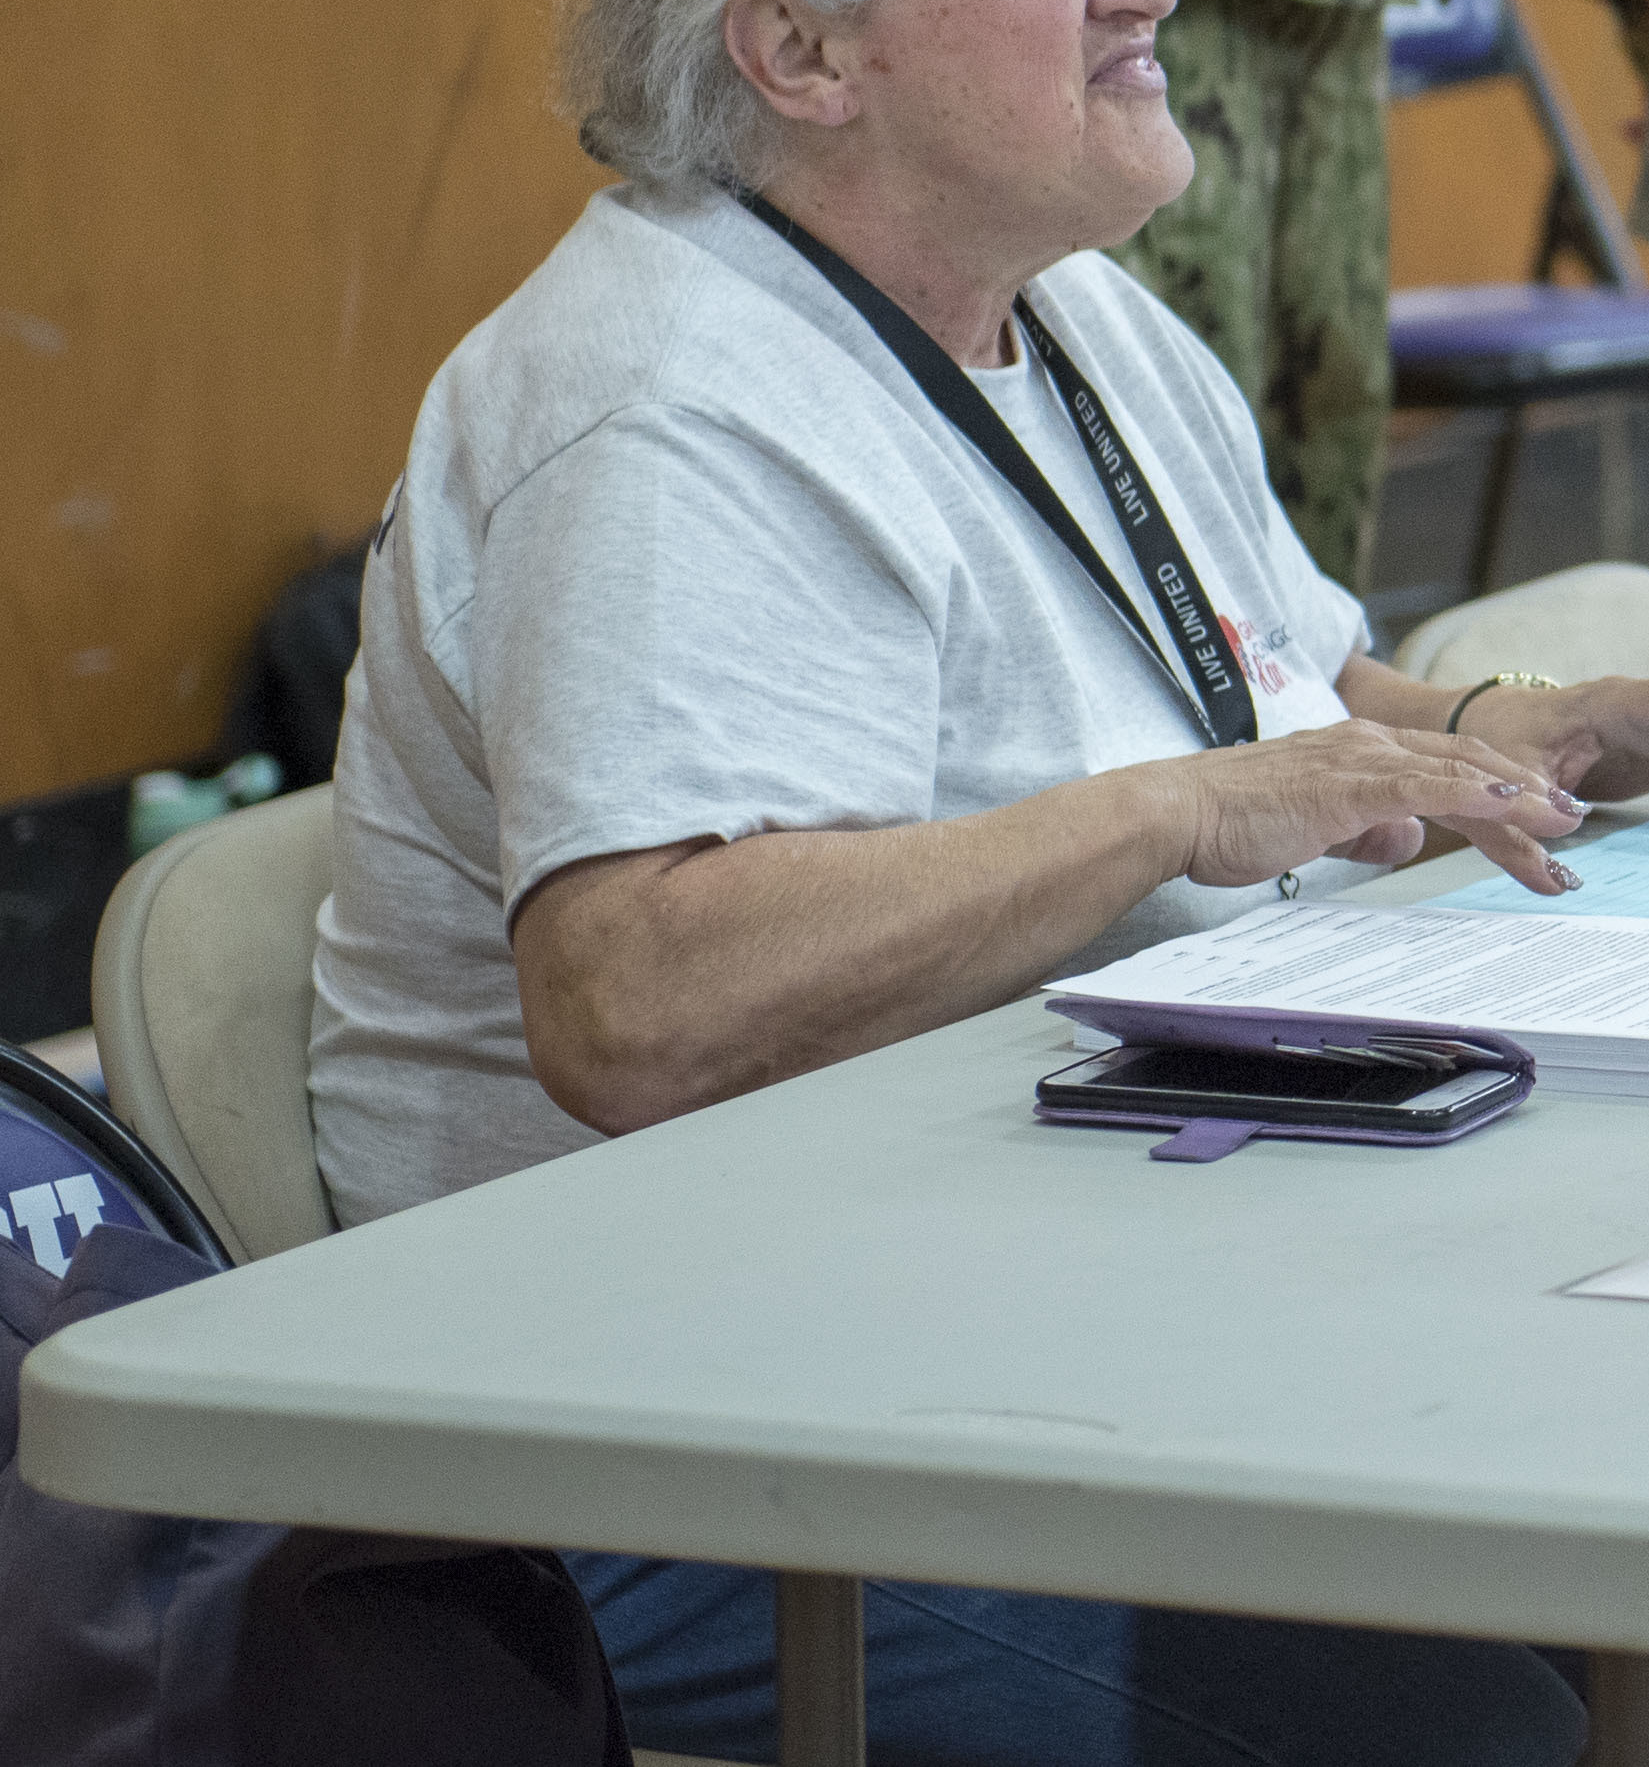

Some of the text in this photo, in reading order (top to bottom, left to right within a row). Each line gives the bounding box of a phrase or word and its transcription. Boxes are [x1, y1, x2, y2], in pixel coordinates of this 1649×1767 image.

[1075, 390, 1149, 527] LIVE UNITED
[1158, 562, 1232, 692] LIVE UNITED
